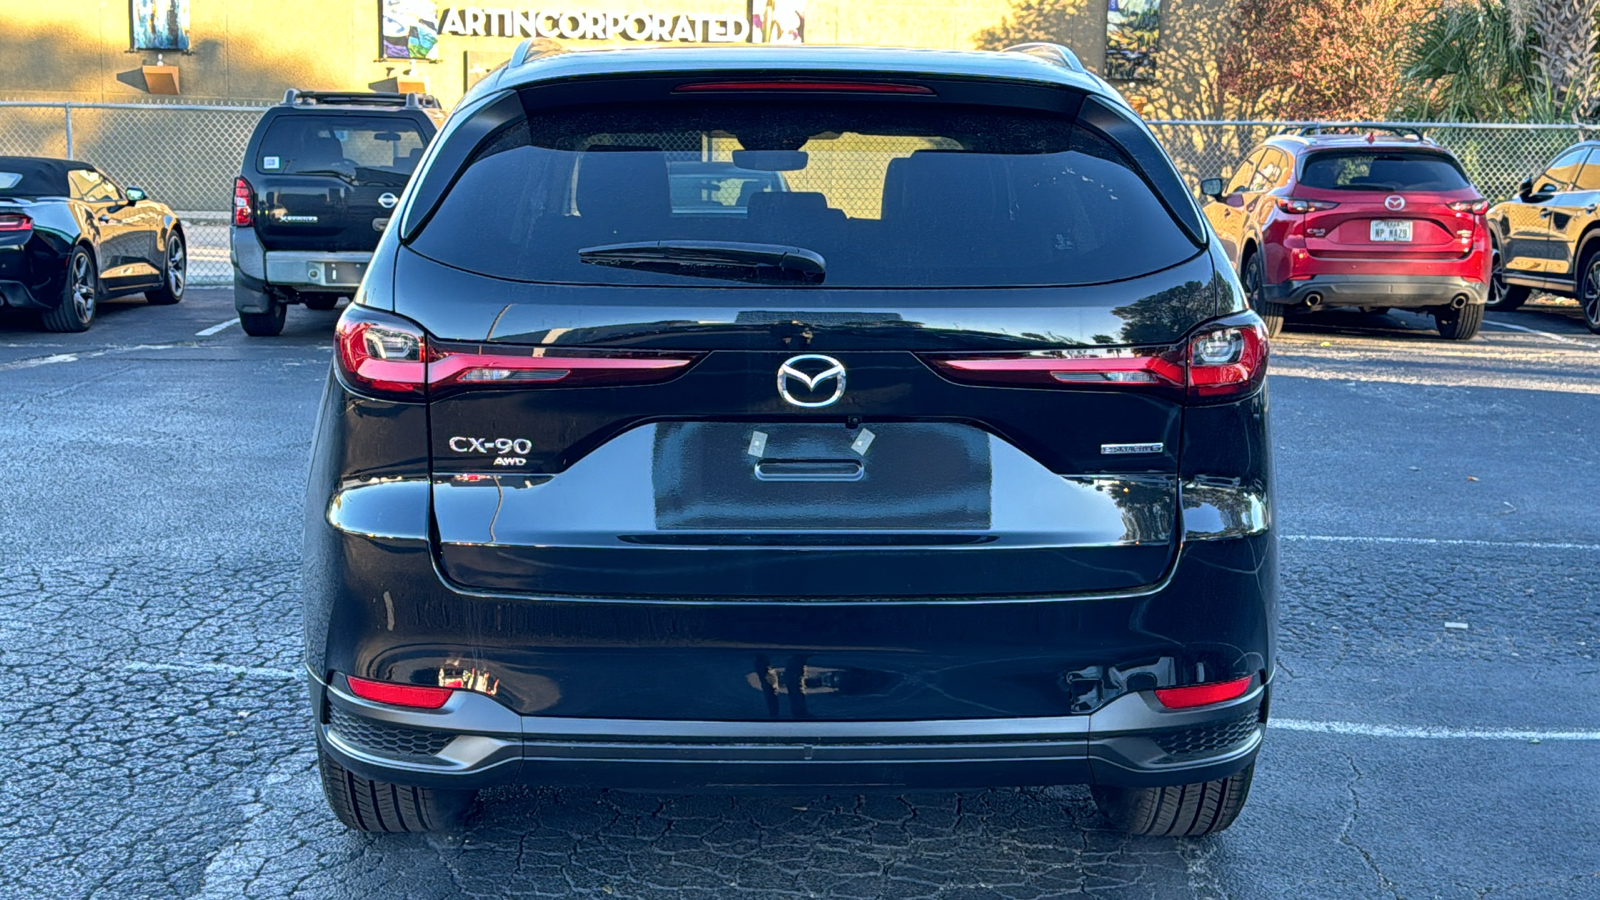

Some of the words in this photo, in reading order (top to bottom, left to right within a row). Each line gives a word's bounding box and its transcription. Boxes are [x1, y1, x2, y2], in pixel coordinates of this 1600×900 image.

[439, 8, 750, 42] ARTINCORPORATED
[448, 436, 532, 454] CX-90
[493, 457, 527, 466] AWD
